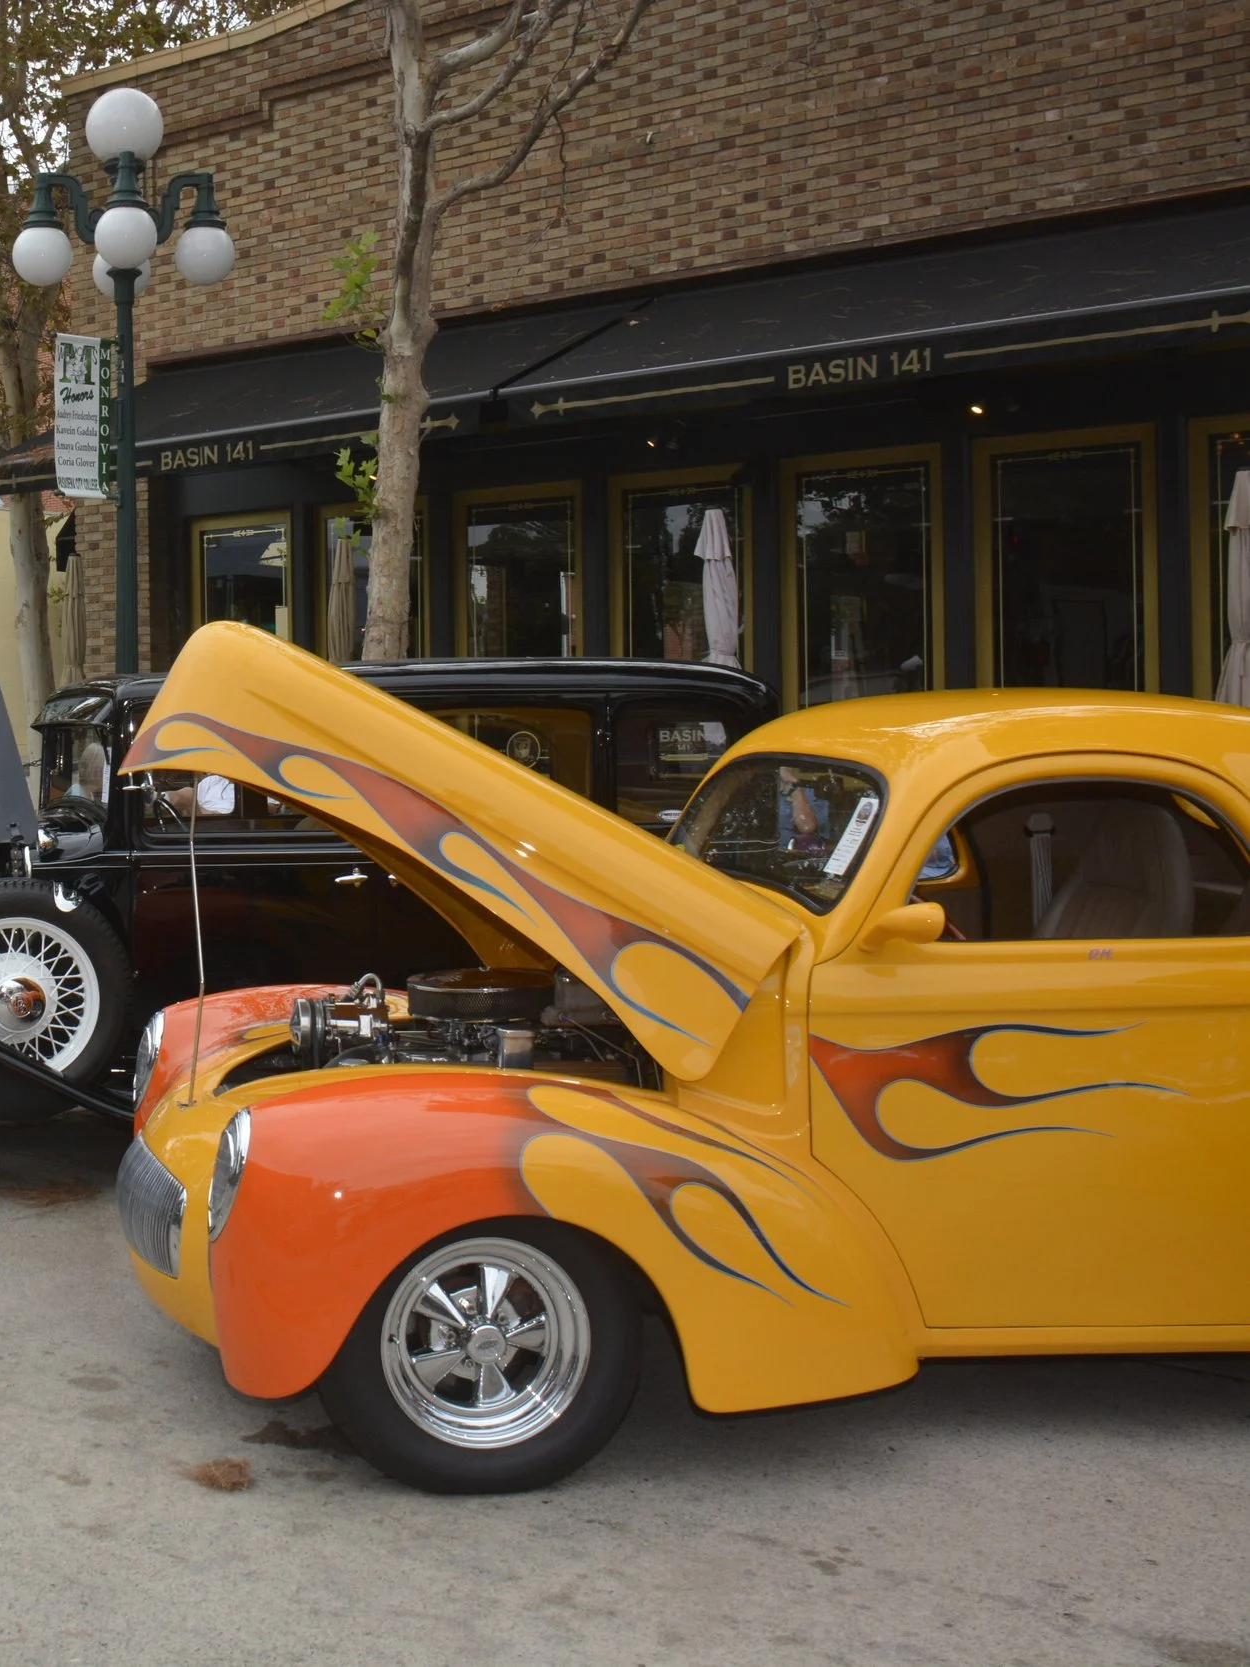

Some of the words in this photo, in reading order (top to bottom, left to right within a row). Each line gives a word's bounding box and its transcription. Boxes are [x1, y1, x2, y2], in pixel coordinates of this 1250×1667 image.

[787, 354, 878, 390] BASIN
[889, 347, 932, 377] 141
[59, 386, 95, 405] Honors
[72, 410, 99, 424] Friedenberg
[100, 348, 111, 492] MONROVIA
[56, 425, 76, 436] Kavein
[77, 426, 98, 437] Gadala
[75, 441, 98, 452] Gamboa
[58, 455, 74, 466] Coria
[75, 457, 96, 468] Glover
[160, 444, 218, 472] BASIN
[226, 440, 254, 463] 141
[659, 729, 708, 742] BASIN
